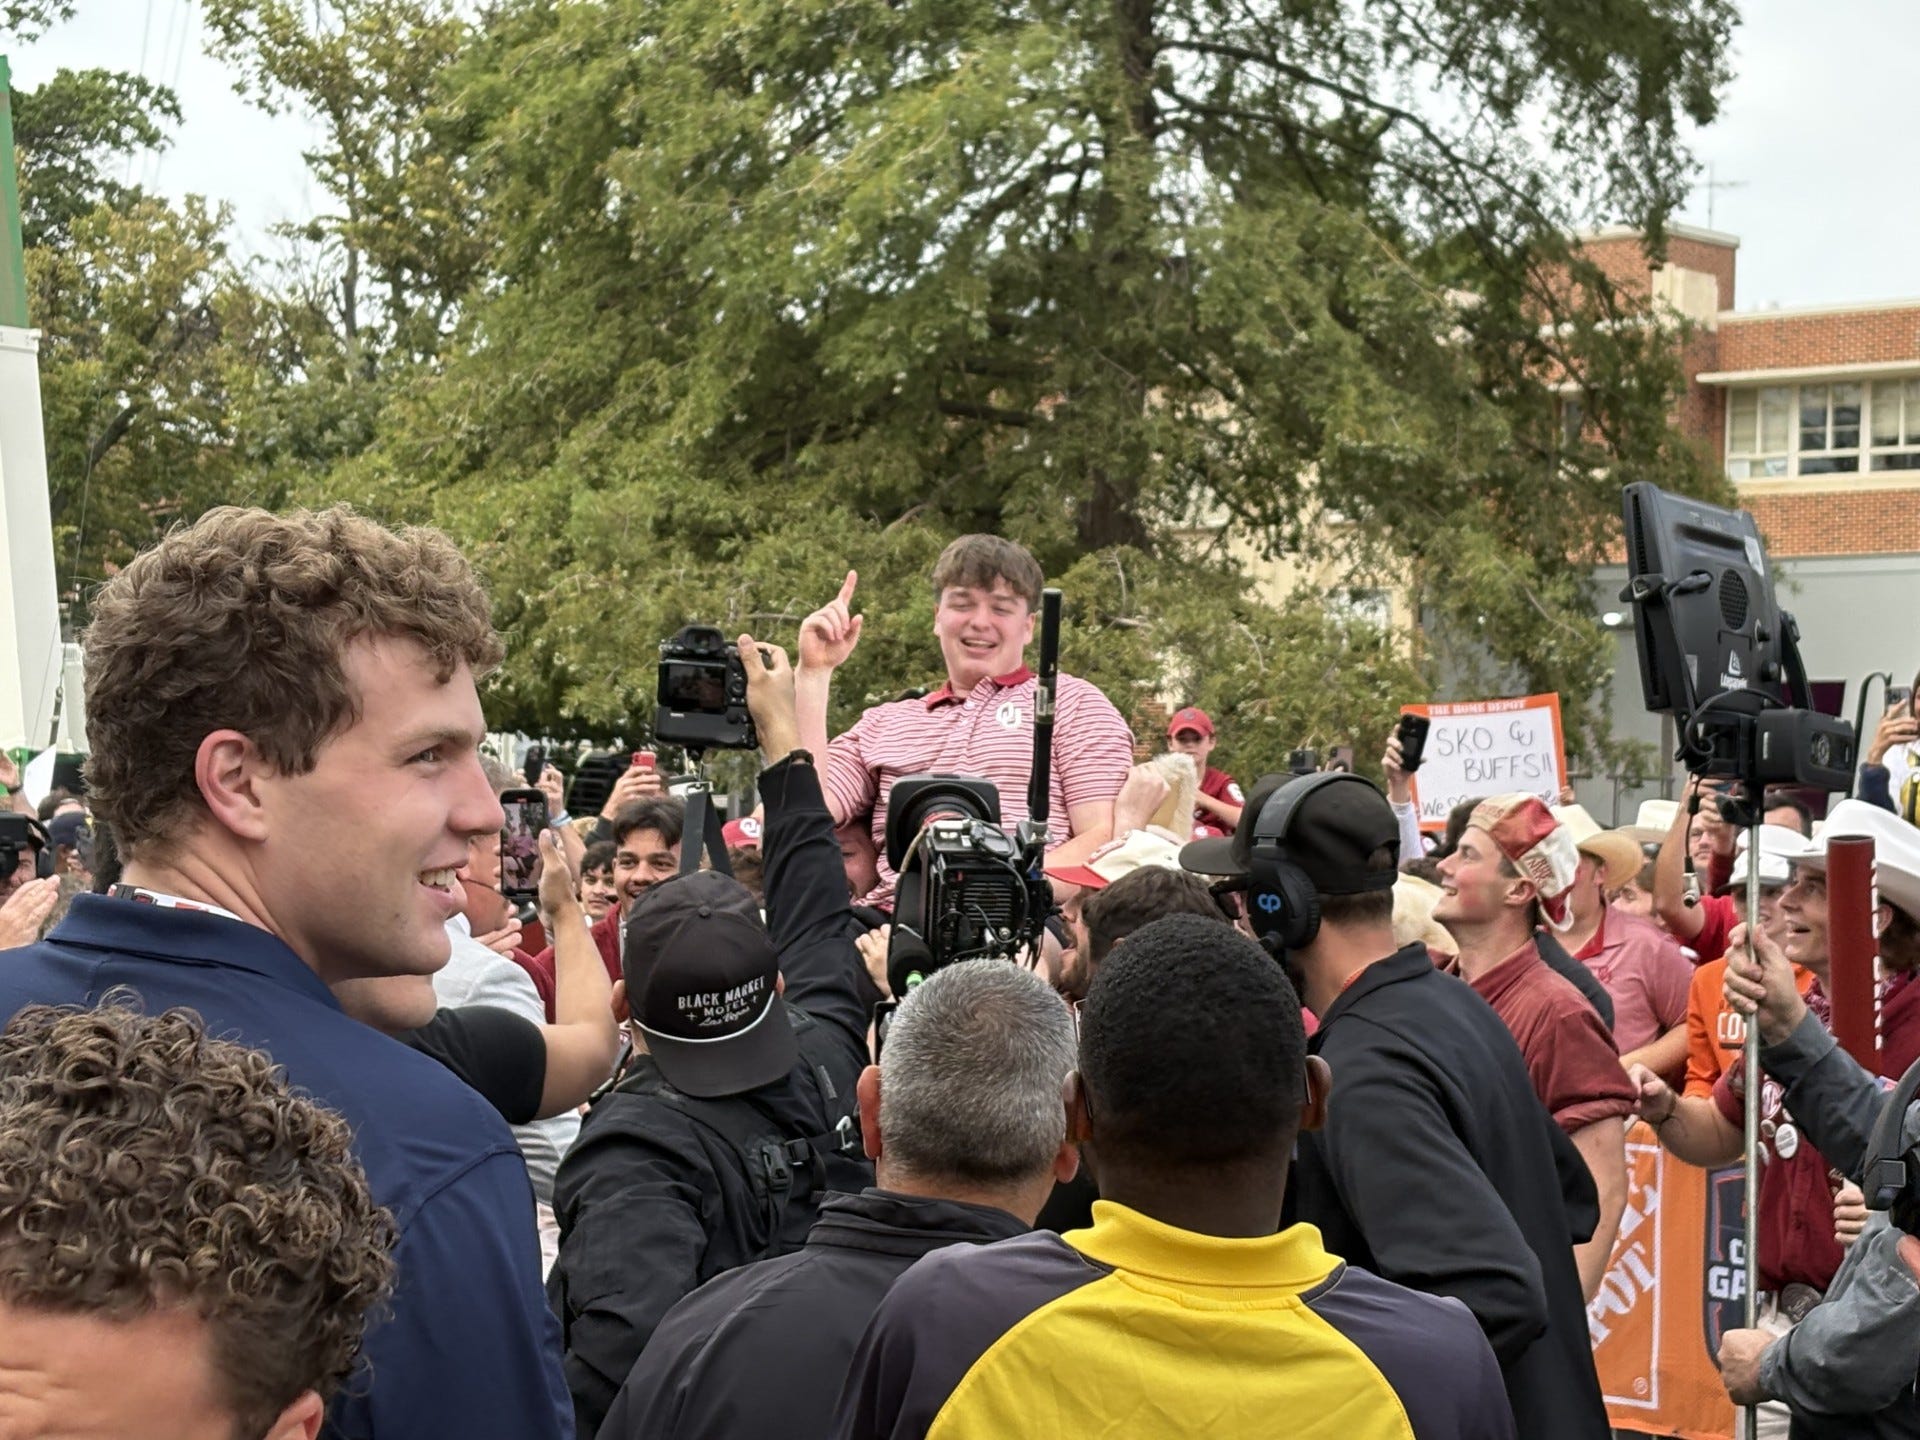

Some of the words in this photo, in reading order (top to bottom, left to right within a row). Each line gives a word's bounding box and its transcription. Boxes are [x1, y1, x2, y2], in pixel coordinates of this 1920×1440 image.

[1436, 726, 1493, 756] SKO
[678, 992, 720, 1010] BLACK
[724, 976, 765, 1003] MARKET
[703, 998, 747, 1017] MOTEL
